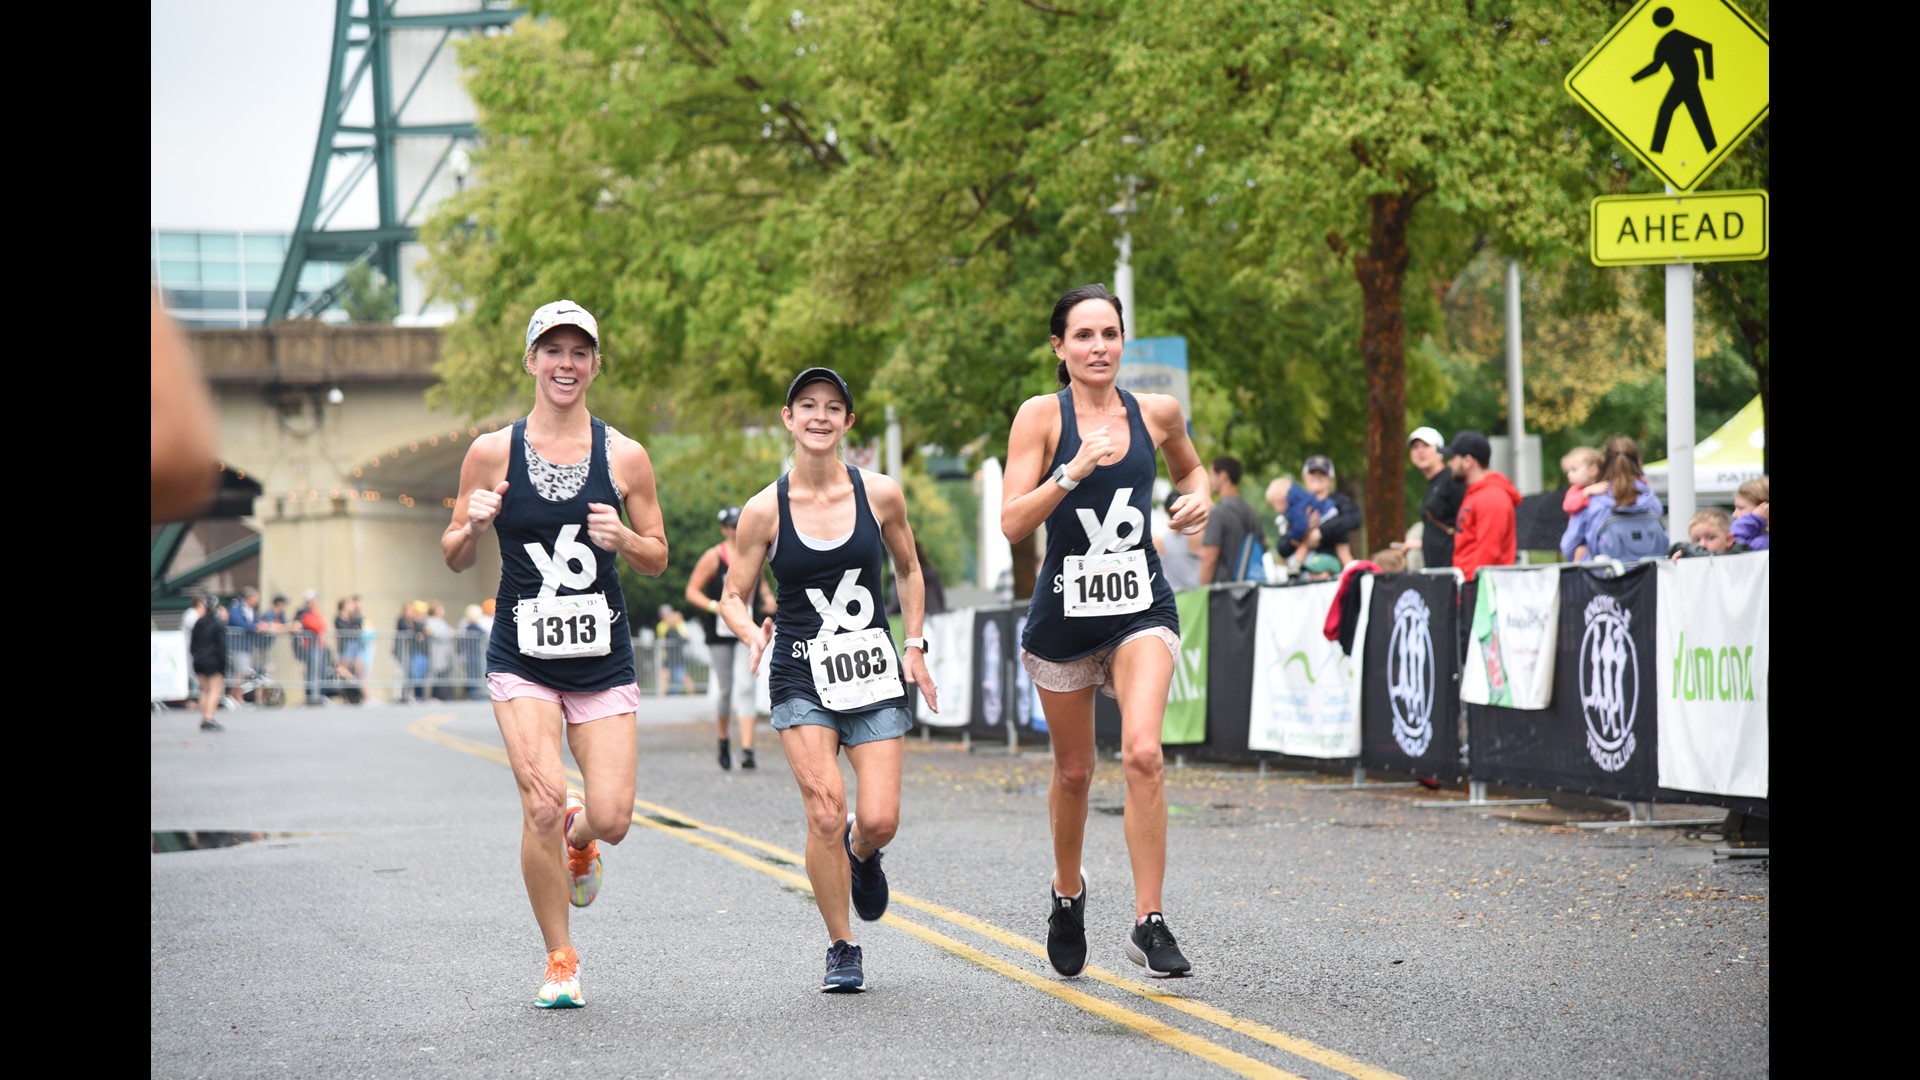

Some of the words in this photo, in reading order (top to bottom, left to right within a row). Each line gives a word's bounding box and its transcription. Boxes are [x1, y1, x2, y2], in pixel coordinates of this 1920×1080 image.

[1617, 211, 1744, 243] AHEAD
[1074, 570, 1139, 603] 1406
[531, 614, 597, 647] 1313
[823, 643, 828, 652] A
[820, 646, 887, 684] 1083
